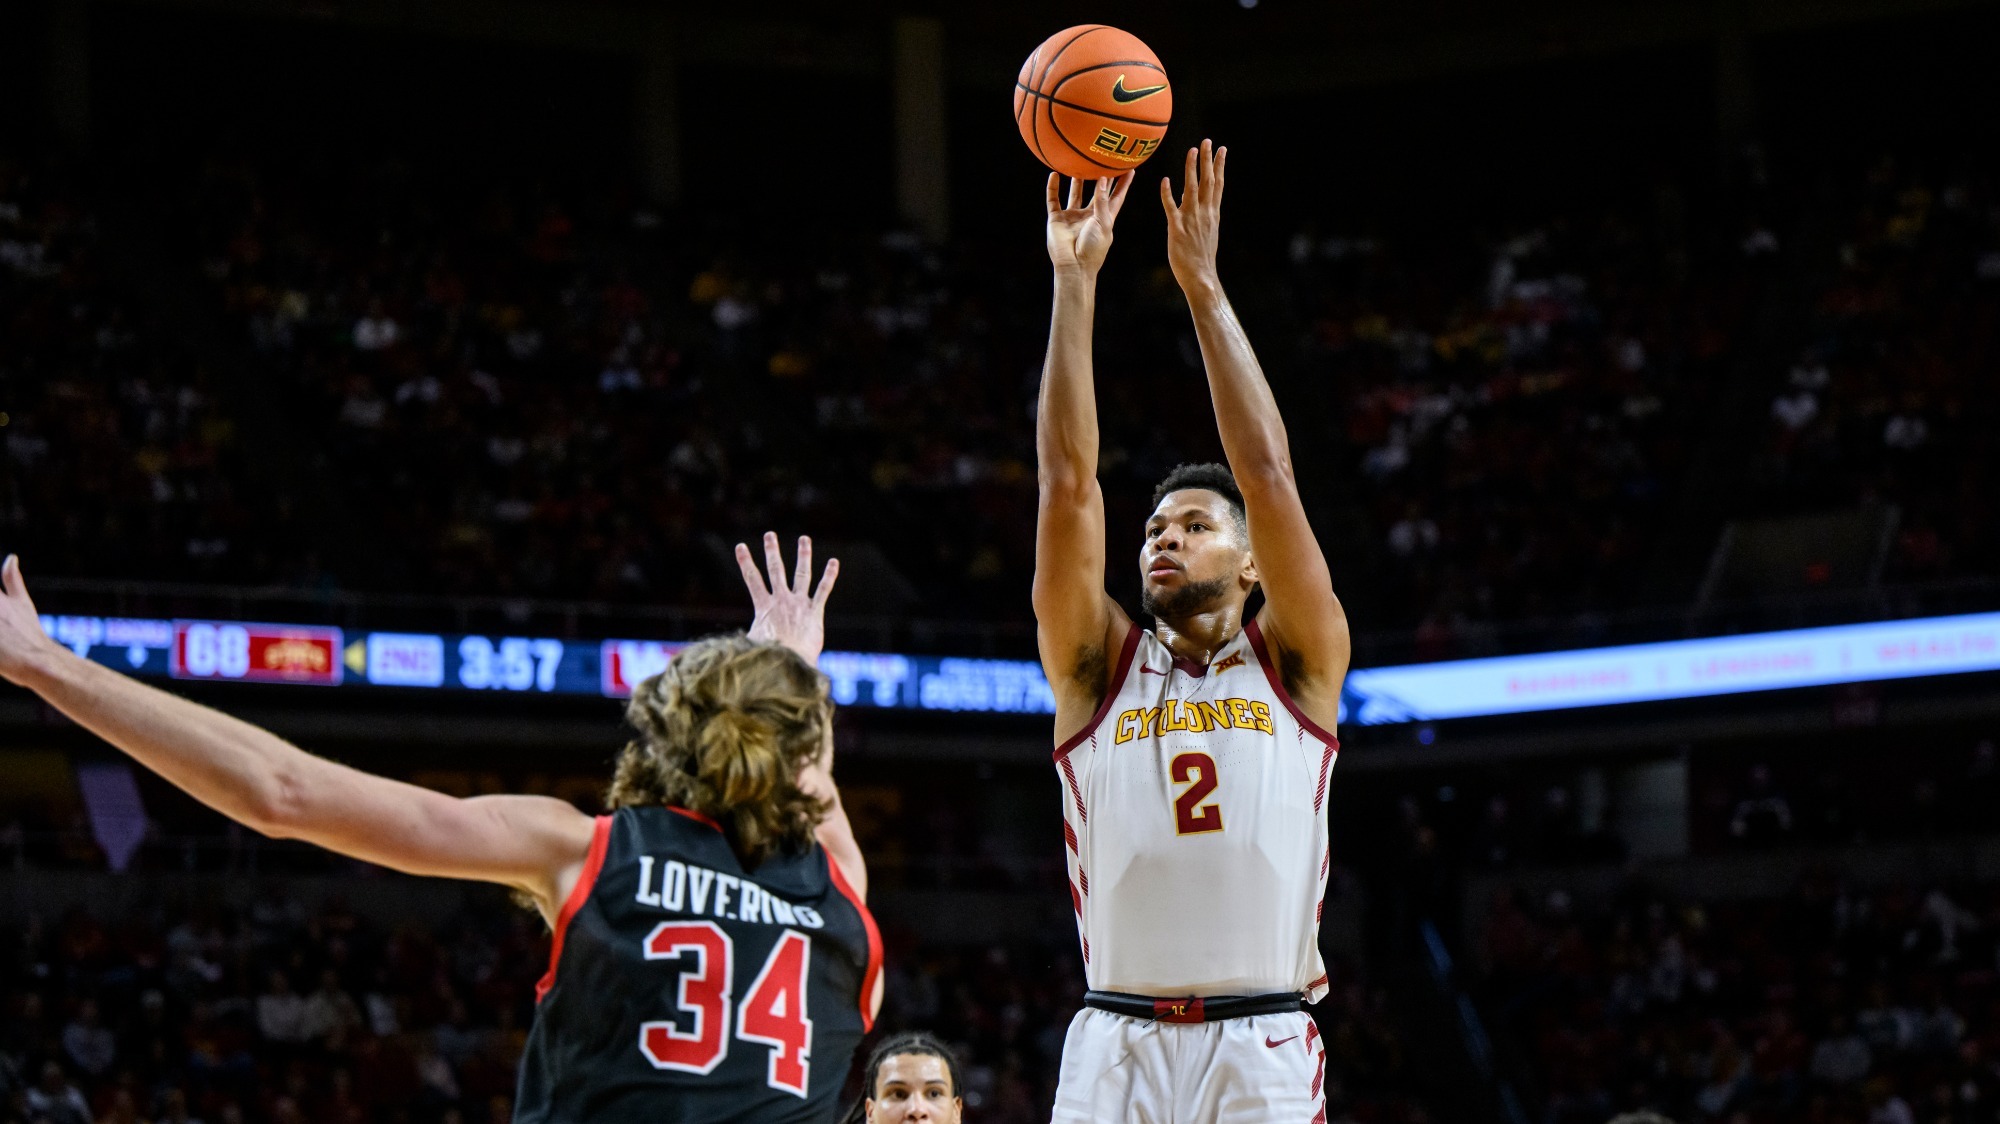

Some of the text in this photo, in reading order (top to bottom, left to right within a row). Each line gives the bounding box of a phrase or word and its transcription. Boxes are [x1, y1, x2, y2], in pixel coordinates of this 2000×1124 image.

[1093, 126, 1161, 158] ELITE
[187, 623, 249, 678] 68
[459, 635, 564, 691] 3:57
[1114, 698, 1273, 745] CYCLONES
[1169, 752, 1224, 836] 2
[635, 855, 825, 929] LOVERING
[639, 920, 813, 1099] 34
